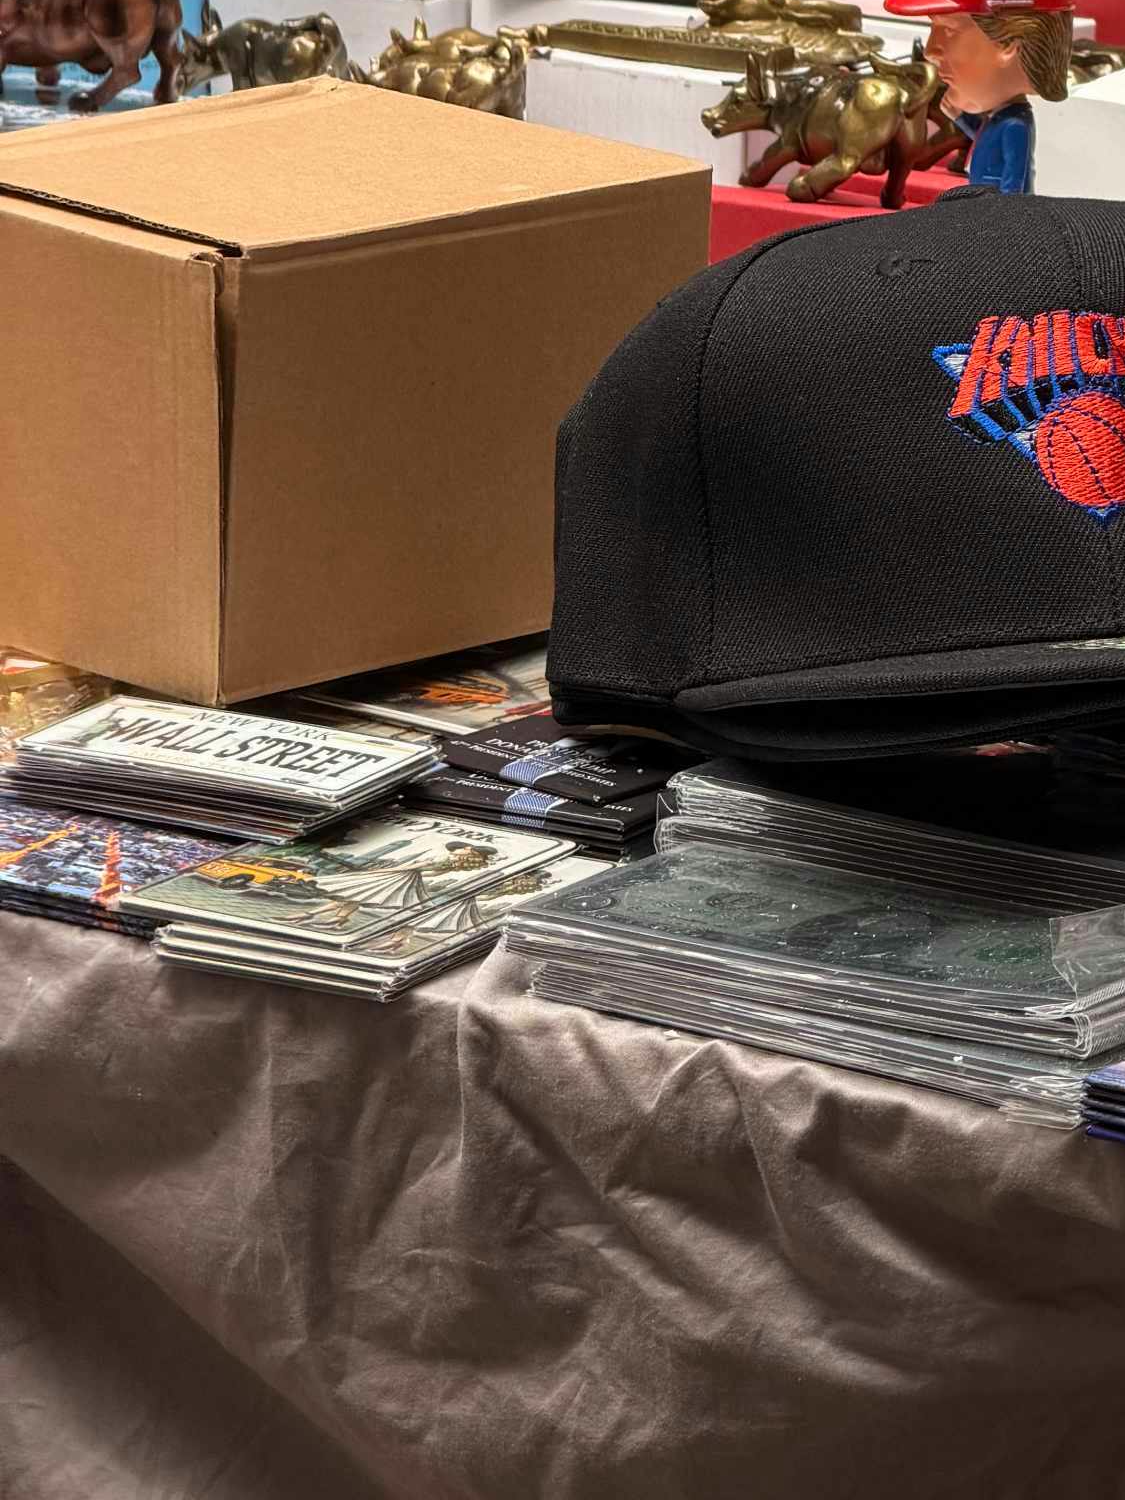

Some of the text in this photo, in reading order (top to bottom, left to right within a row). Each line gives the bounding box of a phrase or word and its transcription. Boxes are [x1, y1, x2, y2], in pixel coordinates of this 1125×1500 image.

[104, 717, 237, 754] WALL
[214, 734, 387, 778] STREET
[190, 711, 338, 742] NEW YORK
